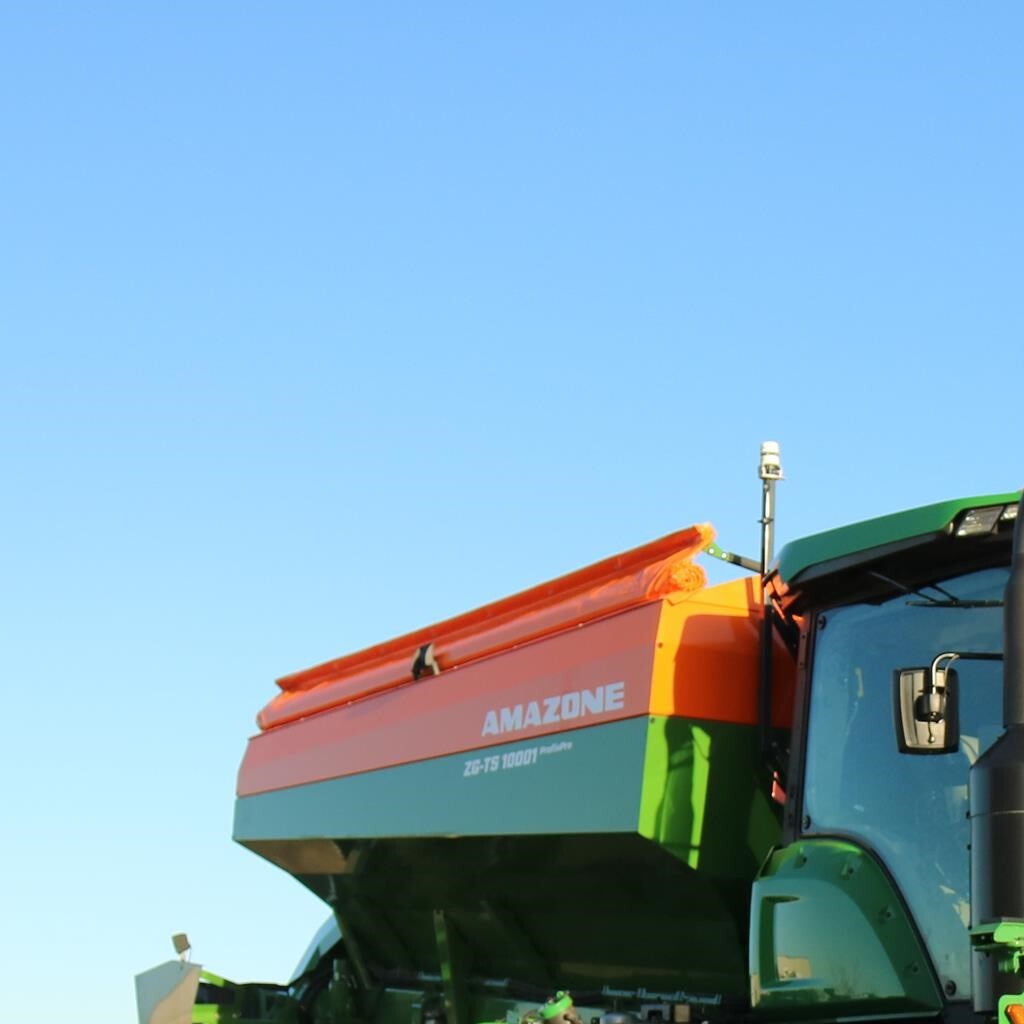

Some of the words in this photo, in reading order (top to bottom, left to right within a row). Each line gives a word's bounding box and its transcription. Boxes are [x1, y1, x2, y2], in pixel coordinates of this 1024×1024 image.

[480, 681, 625, 737] AMAZONE
[463, 755, 500, 777] ZG-TS
[502, 747, 538, 769] 10001
